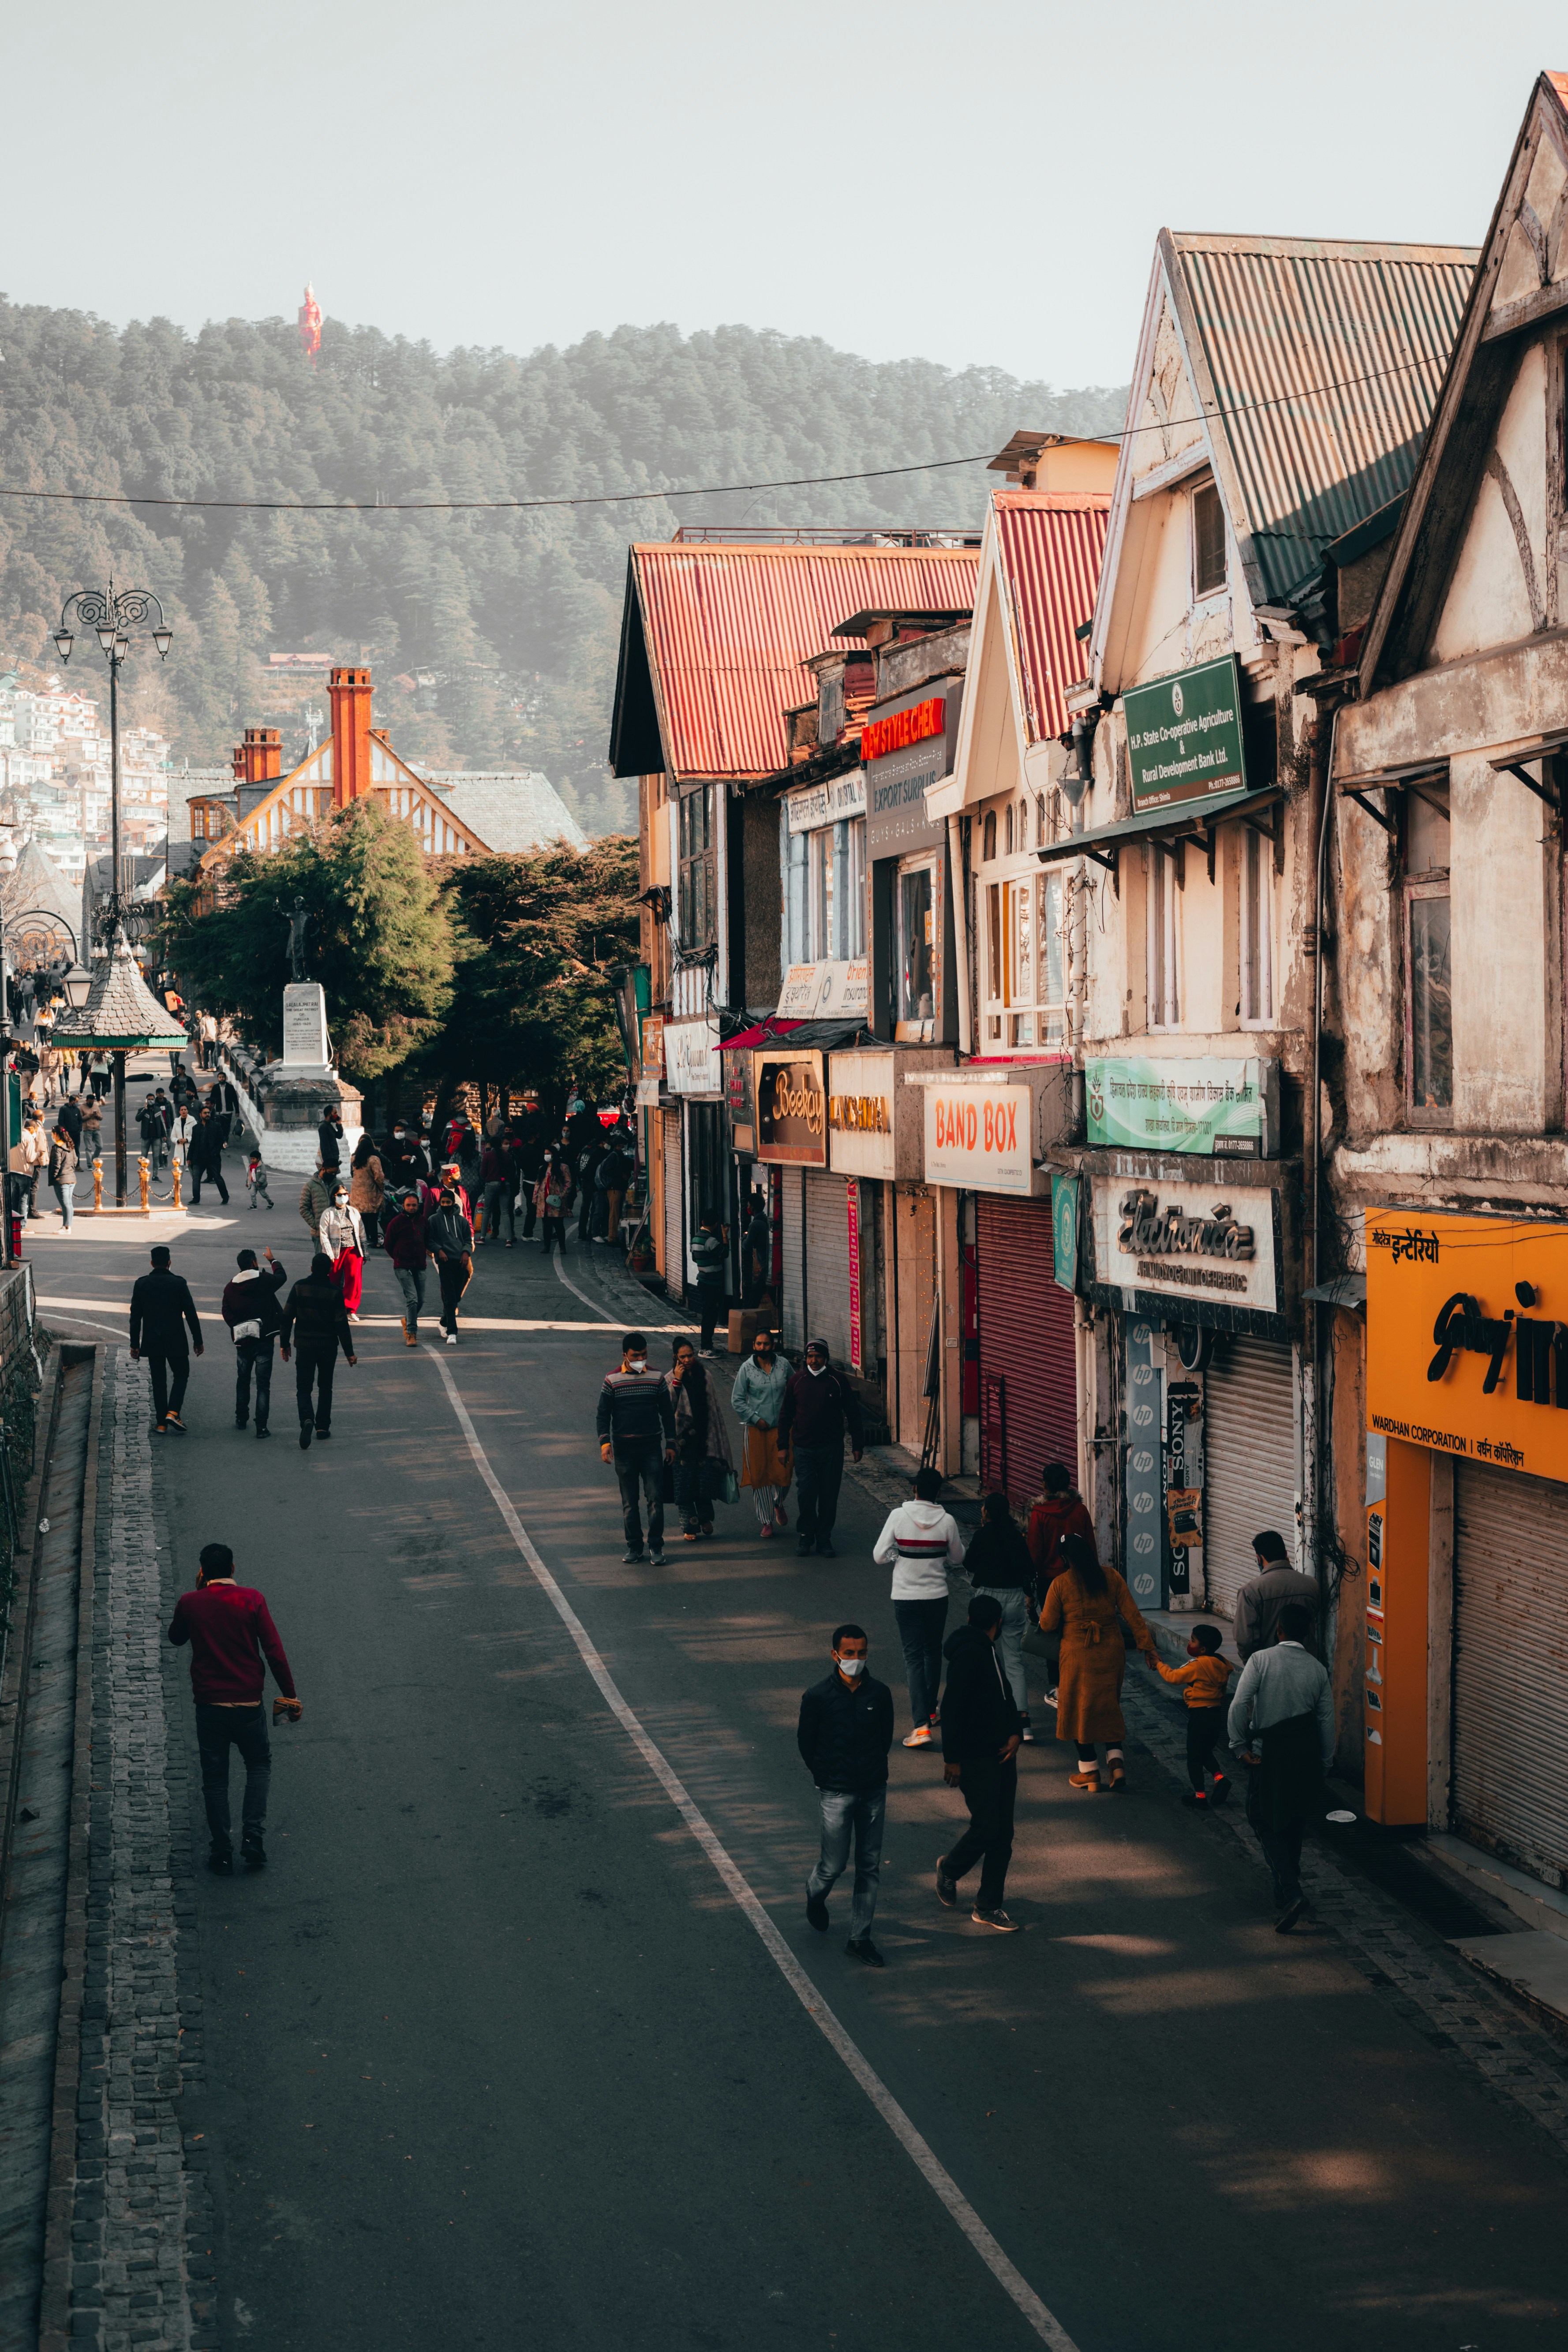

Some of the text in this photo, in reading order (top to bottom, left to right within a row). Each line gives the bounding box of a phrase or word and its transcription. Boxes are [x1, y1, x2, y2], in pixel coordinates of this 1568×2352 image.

[881, 710, 910, 753] STYLE
[911, 698, 939, 741] CHEK
[1130, 709, 1234, 750] H.P. State Co-operative Agriculture
[1179, 739, 1185, 755] &
[1142, 747, 1228, 783] Rural Development Bank Ltd.
[875, 770, 936, 813] EXPORT SURPLUS
[1137, 792, 1171, 807] Branch Office: Shimla
[871, 826, 889, 844] GUYS
[896, 818, 914, 838] GALS
[773, 1070, 822, 1135] Beekay
[1110, 1077, 1125, 1099] हिमाचल
[1126, 1078, 1136, 1100] प्रदेश
[1138, 1084, 1148, 1099] राज्य
[1149, 1079, 1165, 1102] सहकारी
[1167, 1080, 1175, 1107] कृषि
[1190, 1080, 1205, 1102] ग्रामीण
[1207, 1081, 1224, 1103] विकास
[936, 1098, 1017, 1154] BAND BOX
[1117, 1189, 1253, 1261] Electronica
[1372, 1227, 1439, 1265] गोदरेज इन्टेरियो
[1183, 1267, 1201, 1285] UNIT
[1201, 1269, 1213, 1286] OF
[1135, 1324, 1151, 1344] hp
[1135, 1364, 1151, 1385] hp
[1135, 1405, 1151, 1426] hp
[1171, 1402, 1184, 1470] SONY
[1372, 1414, 1410, 1437] WARDHAN
[1411, 1425, 1466, 1452] CORPORATION
[1135, 1451, 1152, 1473] hp
[1369, 1456, 1383, 1471] GLEN
[1135, 1492, 1152, 1513] hp
[1136, 1533, 1152, 1554] hp
[1136, 1573, 1153, 1594] hp
